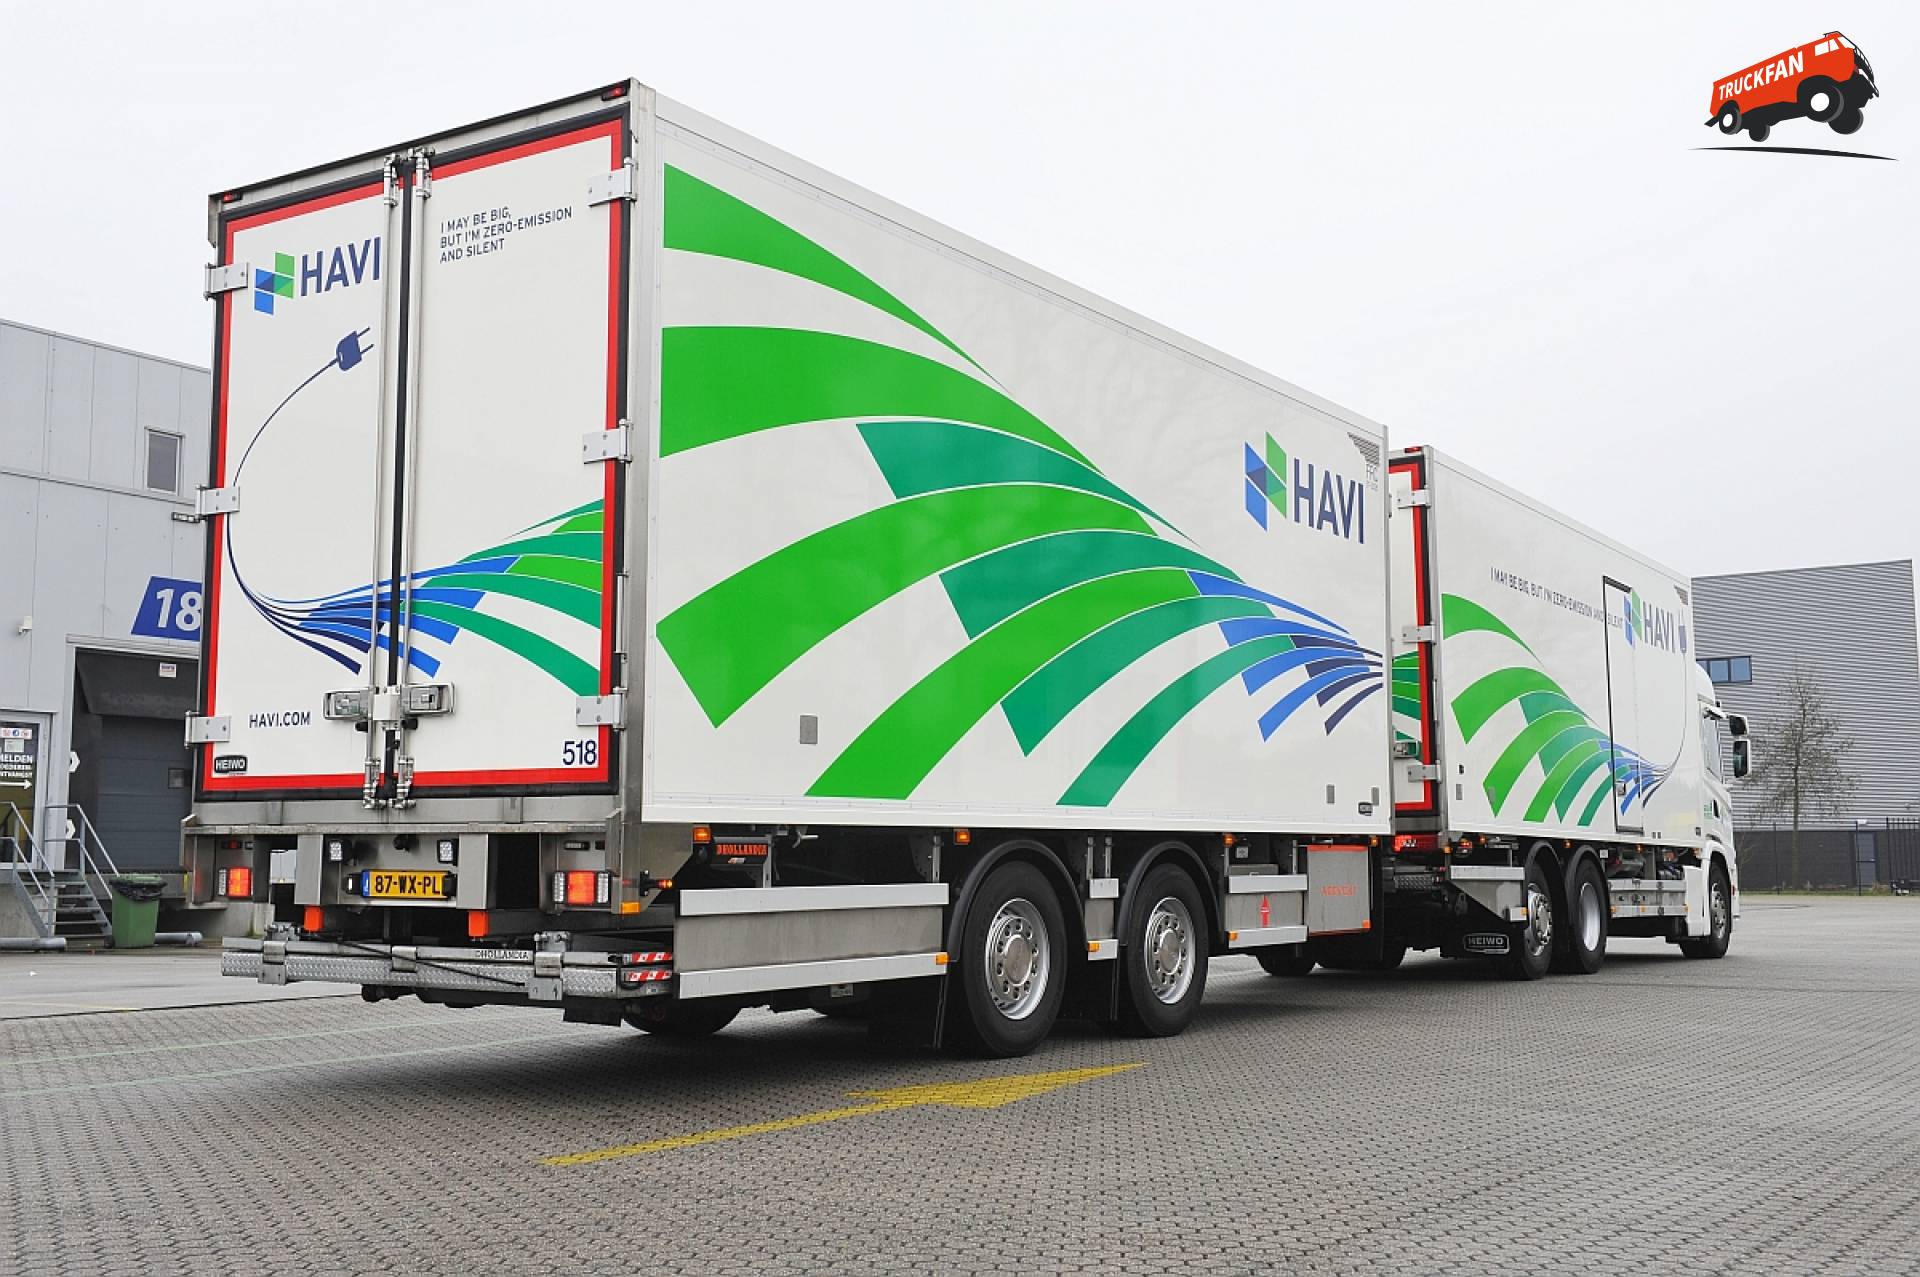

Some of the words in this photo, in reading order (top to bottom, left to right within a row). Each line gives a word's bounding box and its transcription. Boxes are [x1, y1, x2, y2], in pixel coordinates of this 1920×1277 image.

[440, 233, 462, 248] BUT
[465, 229, 480, 242] I'M
[483, 206, 572, 239] ZERO-EMISSION
[447, 216, 469, 232] MAY
[473, 212, 487, 225] BE
[491, 206, 511, 221] BIG,
[440, 248, 462, 264] AND
[466, 238, 505, 257] SILENT
[301, 236, 381, 296] HAVI
[1293, 457, 1364, 544] HAVI
[157, 588, 202, 631] 18
[1643, 600, 1676, 654] HAVI
[249, 710, 311, 728] HAVI.COM
[215, 758, 246, 770] HEIWO
[562, 739, 598, 766] 518
[375, 875, 441, 895] 87-WX-PL
[1468, 937, 1504, 945] HEIWO
